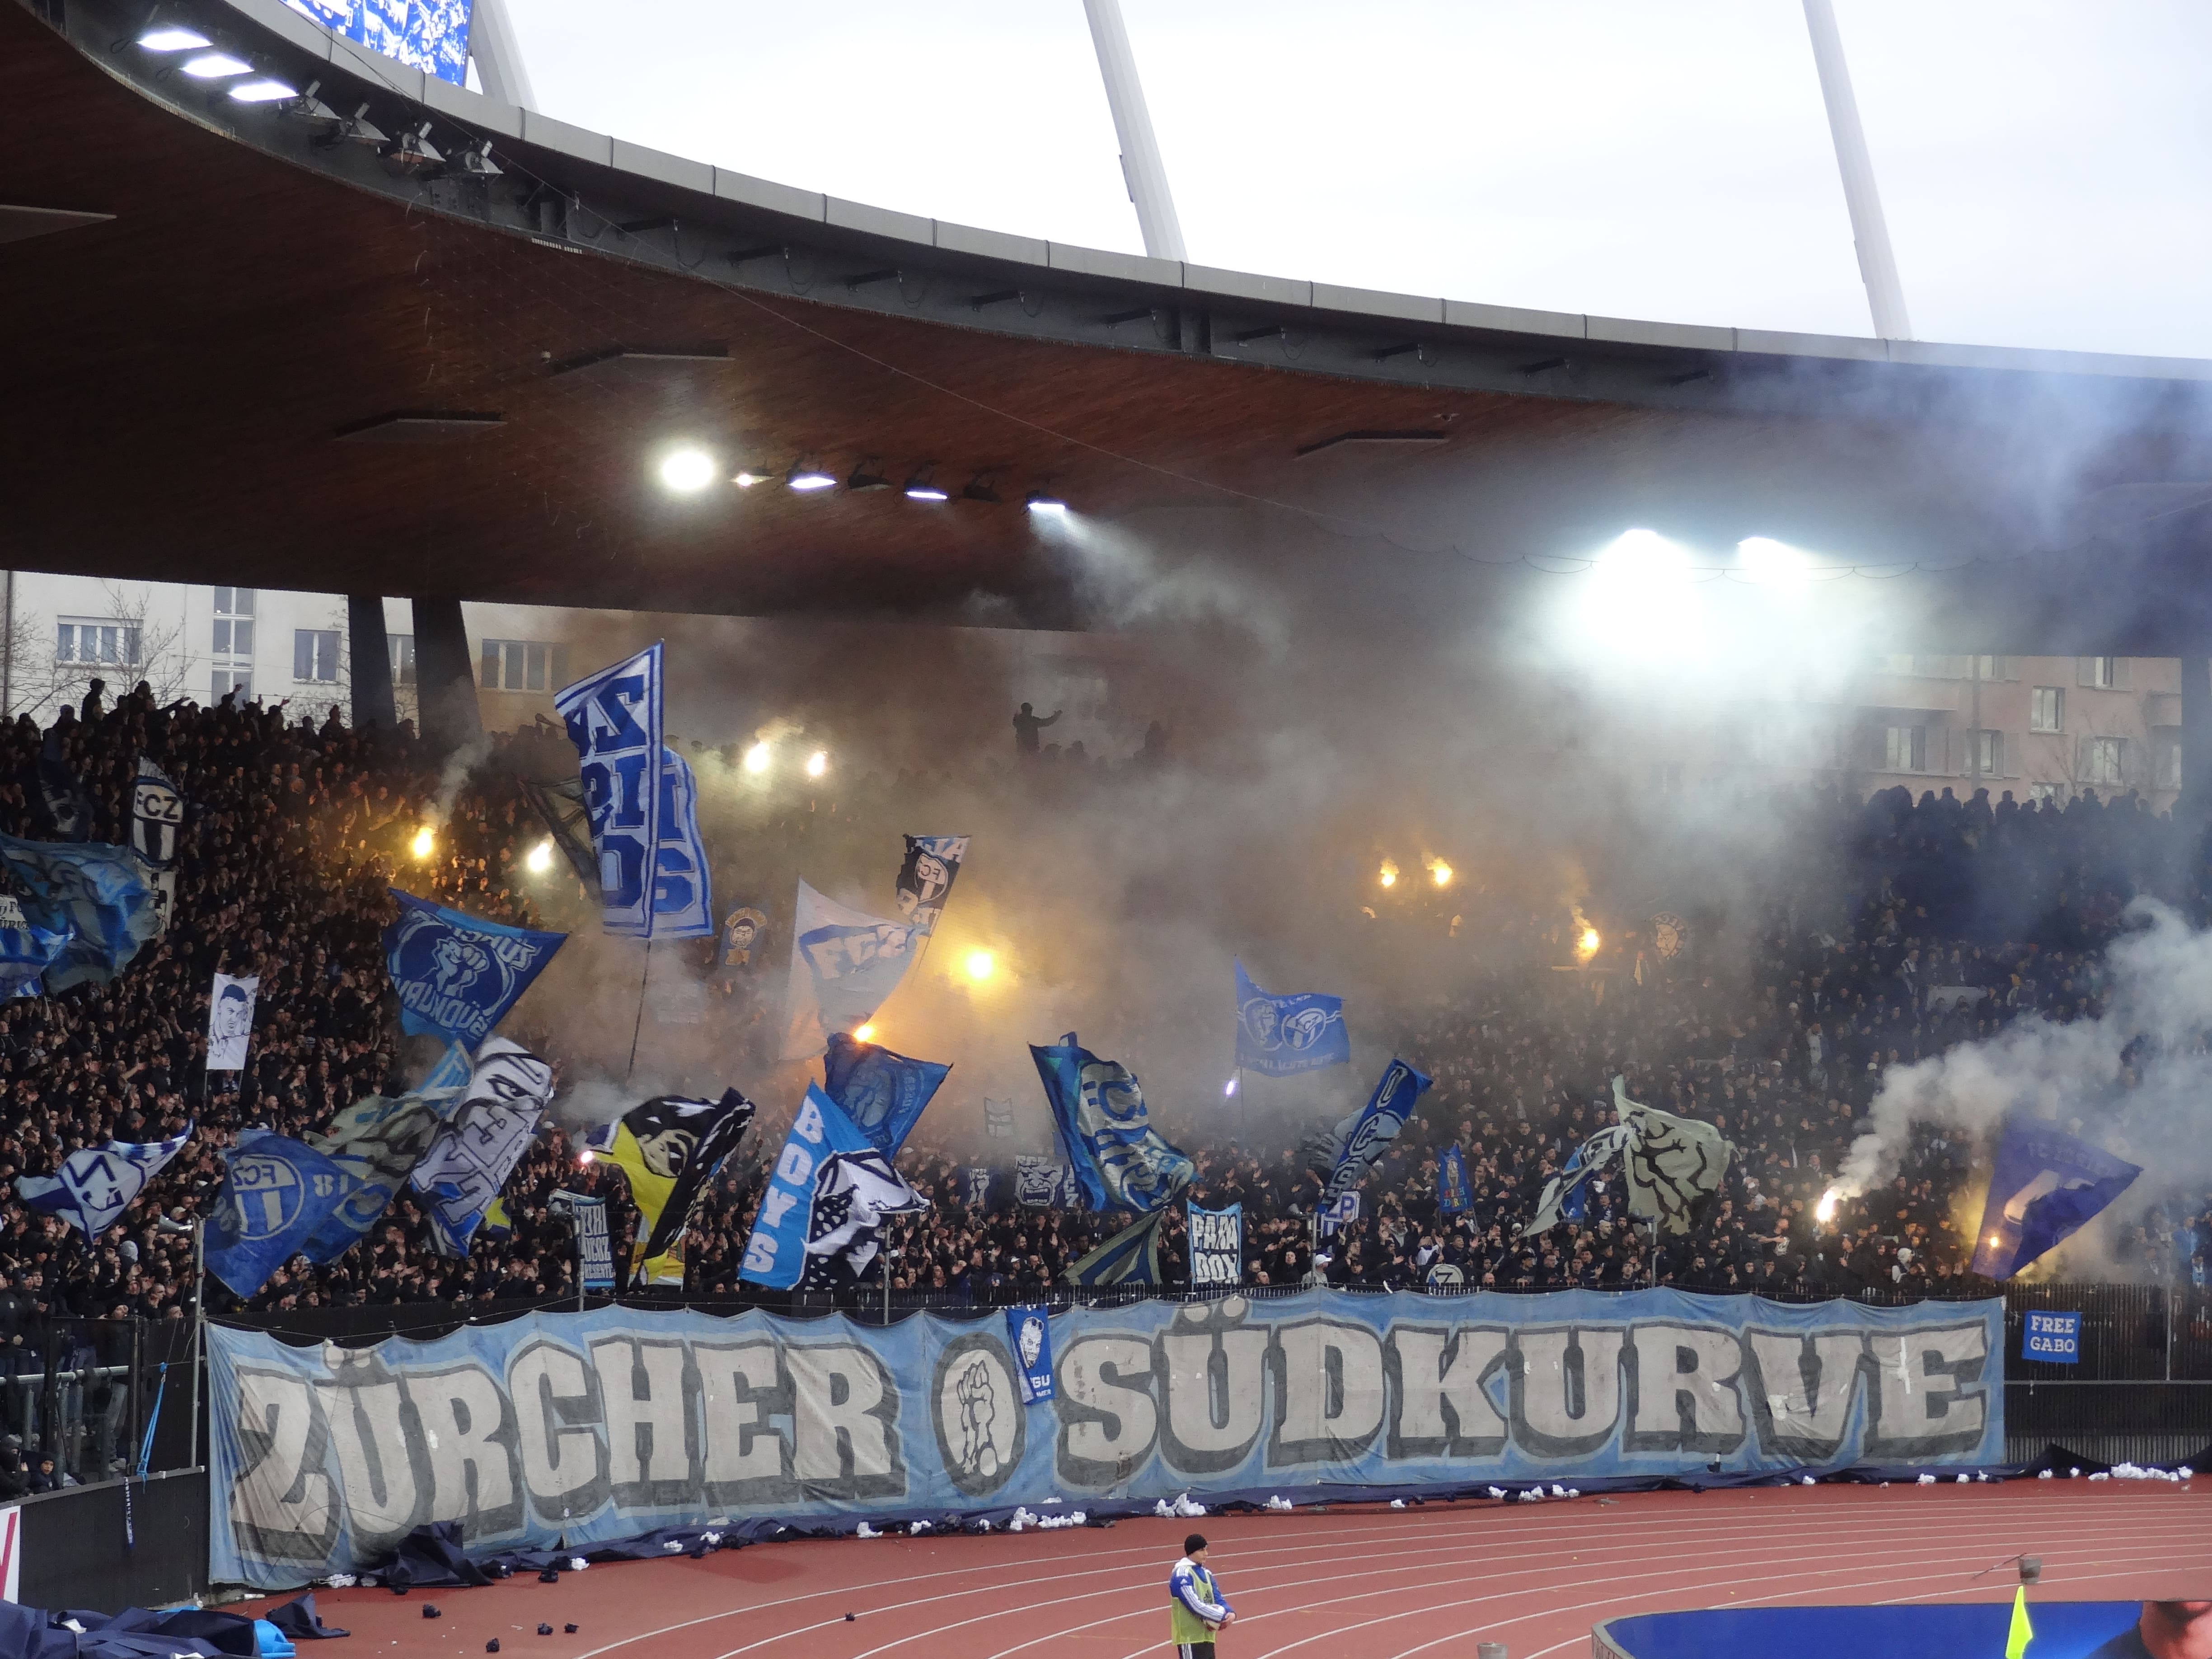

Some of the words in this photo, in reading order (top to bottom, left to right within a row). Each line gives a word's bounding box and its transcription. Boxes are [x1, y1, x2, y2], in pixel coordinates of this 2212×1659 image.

[743, 1095, 825, 1273] BOYS
[1191, 1214, 1238, 1250] PARA
[2031, 1315, 2075, 1333] FREE
[2030, 1336, 2075, 1353] GABO
[231, 1335, 907, 1562] ZÜRCHER
[1055, 1295, 1988, 1487] SÜDKURVE
